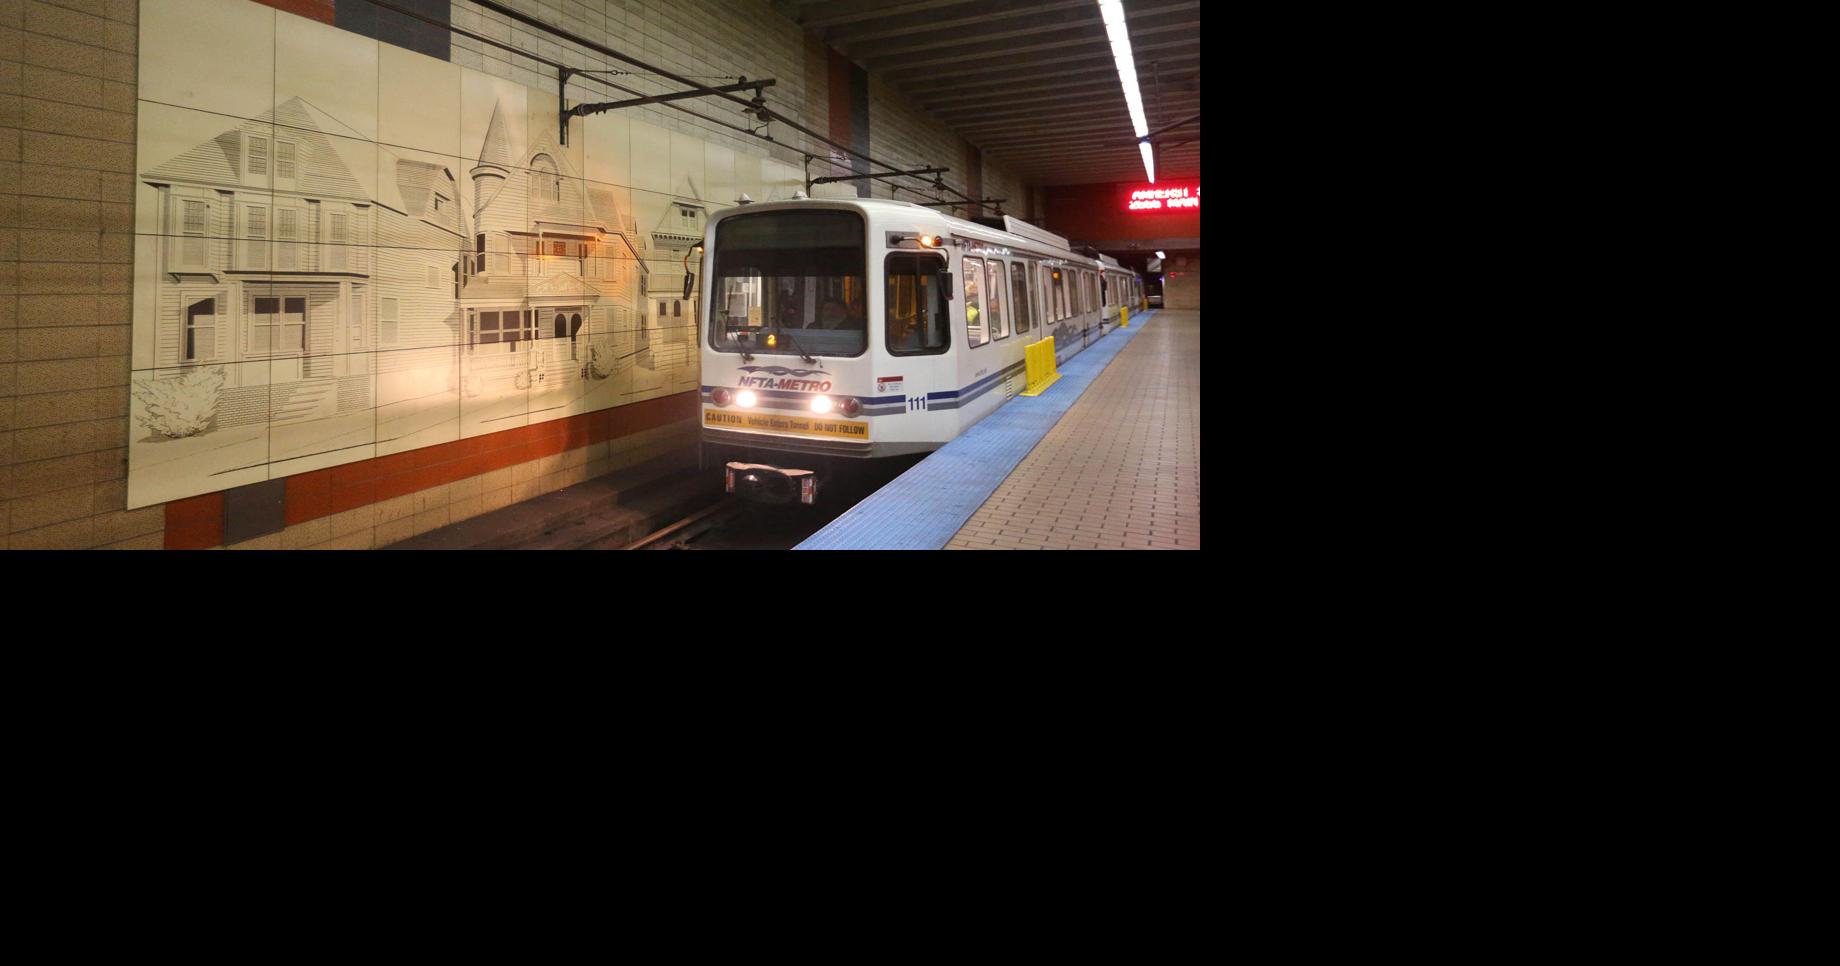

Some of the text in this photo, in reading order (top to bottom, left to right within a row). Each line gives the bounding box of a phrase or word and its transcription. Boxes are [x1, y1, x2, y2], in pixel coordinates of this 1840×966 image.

[767, 334, 776, 345] 2
[738, 376, 832, 392] NFTA-METRO
[908, 396, 926, 411] 111
[705, 412, 742, 424] CAUTION
[814, 422, 823, 431] DO
[824, 423, 837, 432] NOT
[839, 424, 865, 435] FOLLOW
